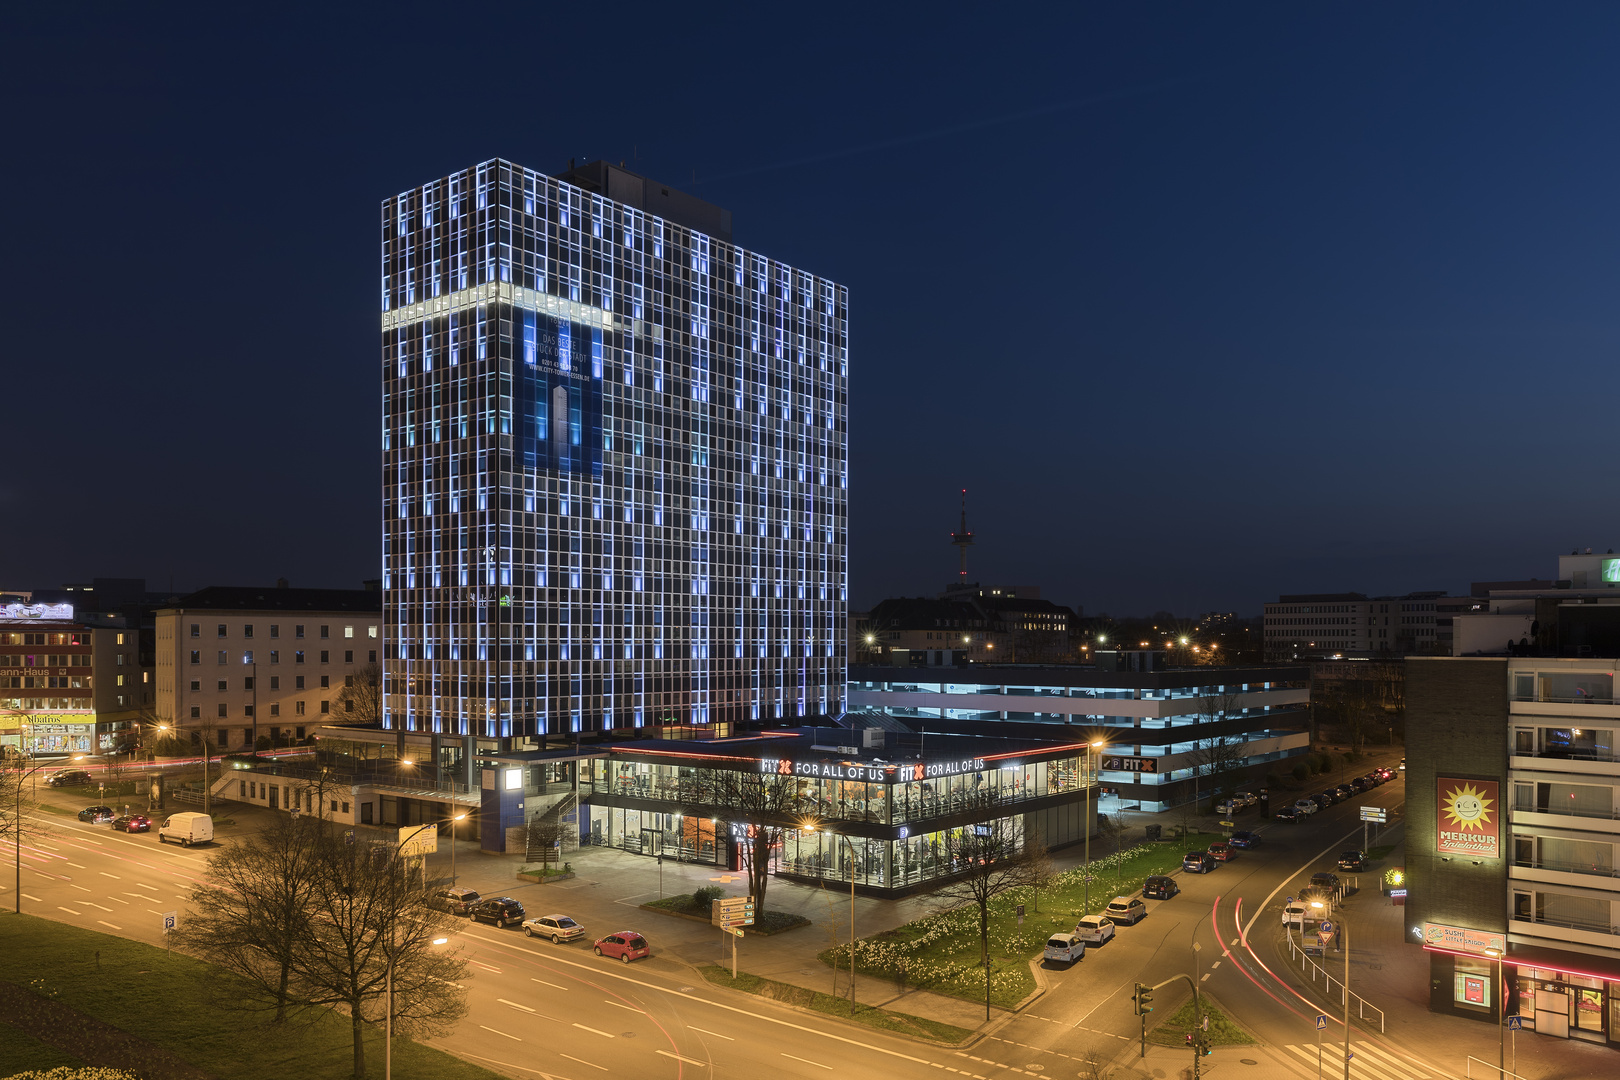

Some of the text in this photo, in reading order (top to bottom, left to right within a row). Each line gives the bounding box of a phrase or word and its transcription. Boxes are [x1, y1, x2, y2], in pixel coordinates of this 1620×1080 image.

[542, 334, 577, 350] DAS BESTE
[531, 343, 587, 363] STÜCK DER STADT
[26, 715, 61, 724] Albatros
[796, 762, 819, 775] FOR
[822, 765, 844, 777] ALL
[847, 767, 864, 779] OF
[869, 769, 884, 780] US
[900, 758, 984, 781] FITX FOR ALL OF US
[1113, 758, 1154, 772] P FITX
[1440, 831, 1496, 845] MERKUR
[1440, 840, 1496, 852] Spielothek
[1444, 928, 1465, 938] SUSHI
[1445, 936, 1463, 944] LITTLE
